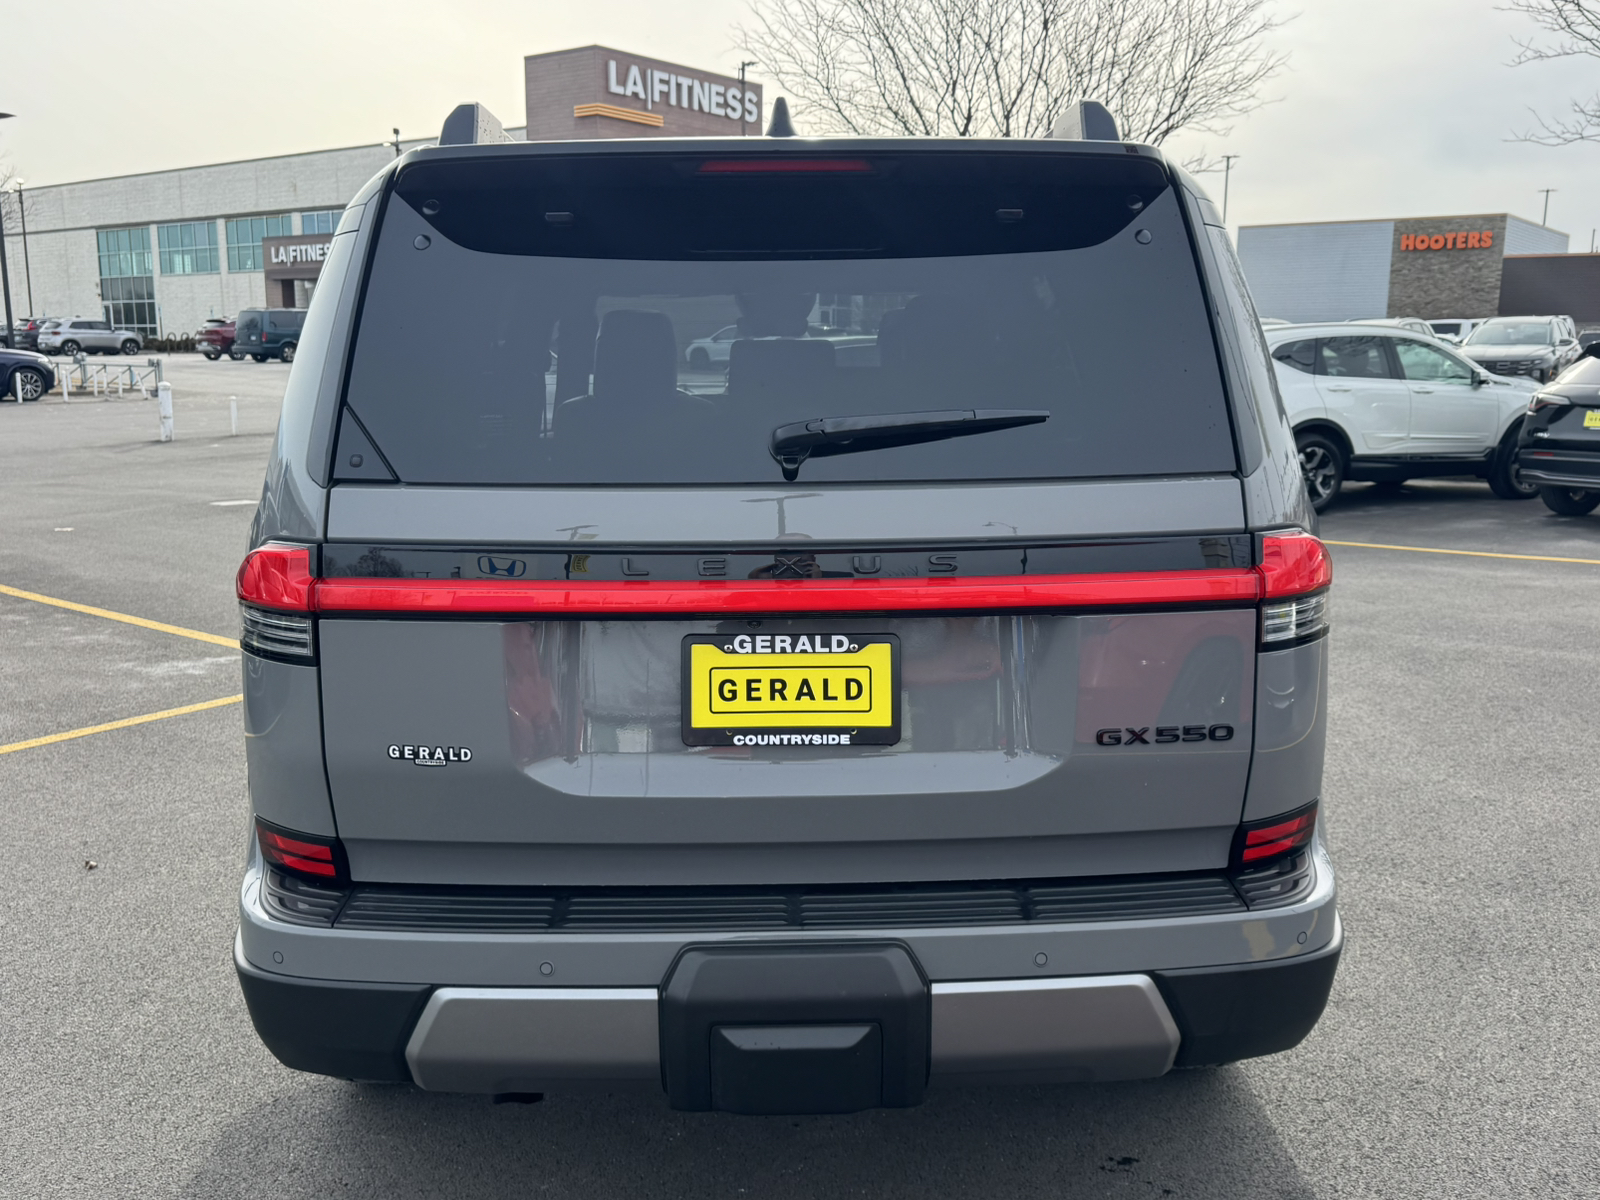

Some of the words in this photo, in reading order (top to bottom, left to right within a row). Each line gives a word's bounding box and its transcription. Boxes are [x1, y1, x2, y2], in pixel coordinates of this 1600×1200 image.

[652, 69, 758, 123] FITNESS
[1400, 230, 1493, 251] HOOTERS
[622, 555, 958, 577] LEXUS
[733, 634, 850, 654] GERALD
[717, 678, 864, 702] GERALD
[733, 734, 851, 746] COUNTRYSIDE
[388, 744, 472, 761] GERALD
